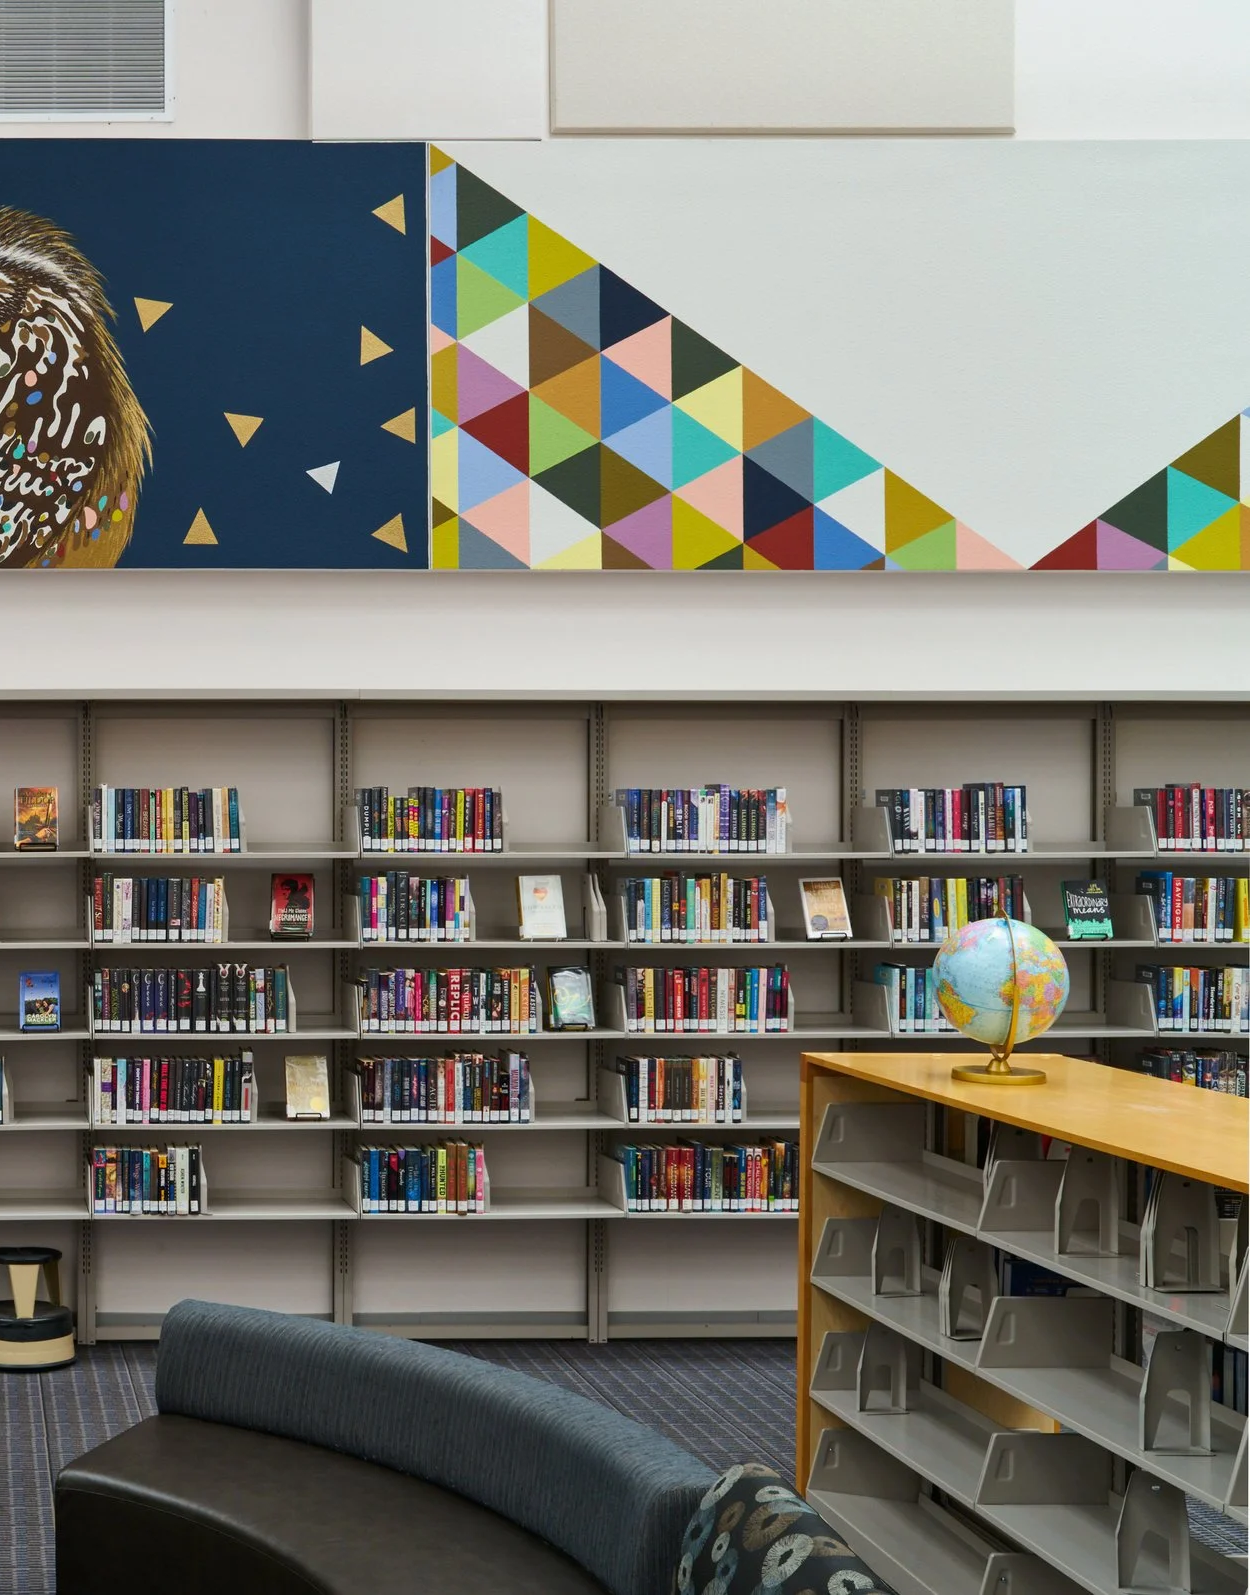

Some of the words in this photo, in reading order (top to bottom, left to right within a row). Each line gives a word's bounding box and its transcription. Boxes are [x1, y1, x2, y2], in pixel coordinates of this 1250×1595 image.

[1066, 890, 1108, 908] EXTRAORDINARY
[1072, 906, 1106, 914] means
[450, 975, 460, 1020] REPLIC
[461, 983, 470, 1020] requiem
[160, 1064, 168, 1077] KILL
[160, 1078, 168, 1089] THE
[160, 1090, 168, 1103] BOY
